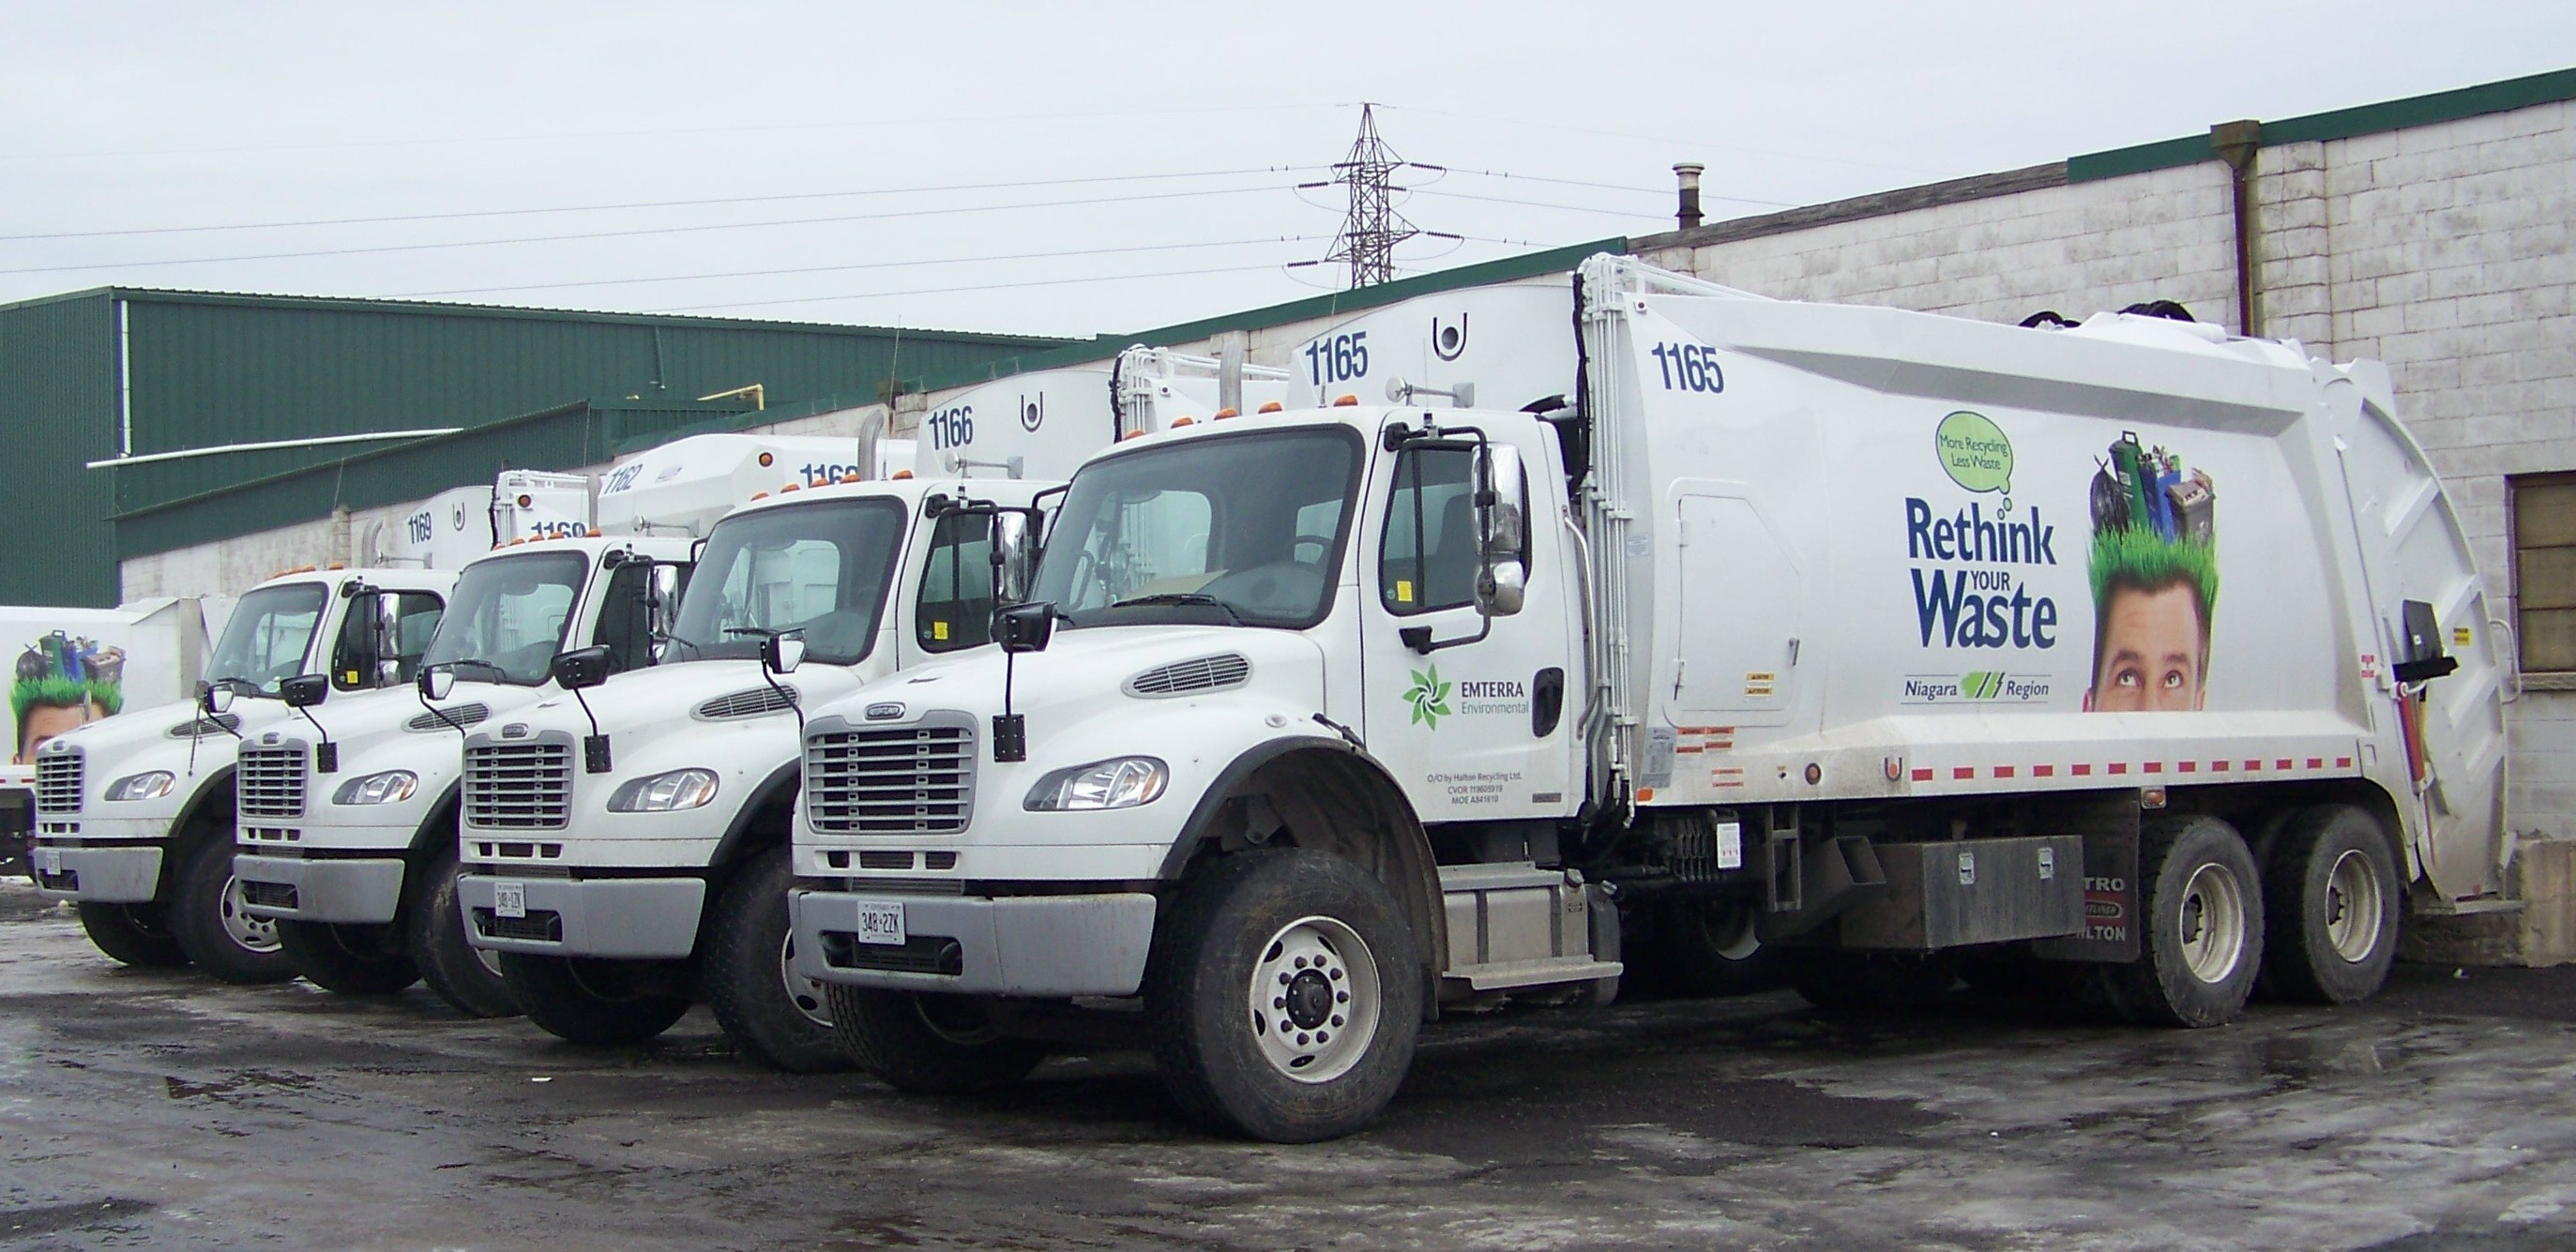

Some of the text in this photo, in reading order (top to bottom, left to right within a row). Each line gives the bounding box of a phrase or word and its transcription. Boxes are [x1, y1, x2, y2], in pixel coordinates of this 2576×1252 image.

[1305, 331, 1369, 386] 1165
[1651, 341, 1725, 394] 1165
[928, 405, 973, 450] 1166
[1939, 433, 2008, 458] More Recycling
[1951, 452, 2001, 470] Less Waste
[603, 463, 644, 495] 1162
[408, 511, 432, 544] 1169
[1904, 497, 2057, 565] Rethink
[1970, 570, 2010, 592] YOUR
[1910, 567, 2057, 649] Waste
[1461, 681, 1524, 698] EMTERRA
[1904, 680, 2049, 701] Niagara Region
[1461, 701, 1529, 715] Environmental
[1444, 773, 1452, 784] by
[1453, 773, 1477, 782] Halton
[1477, 772, 1508, 783] Recycling
[2084, 877, 2126, 891] TRO
[2077, 925, 2126, 942] LTON
